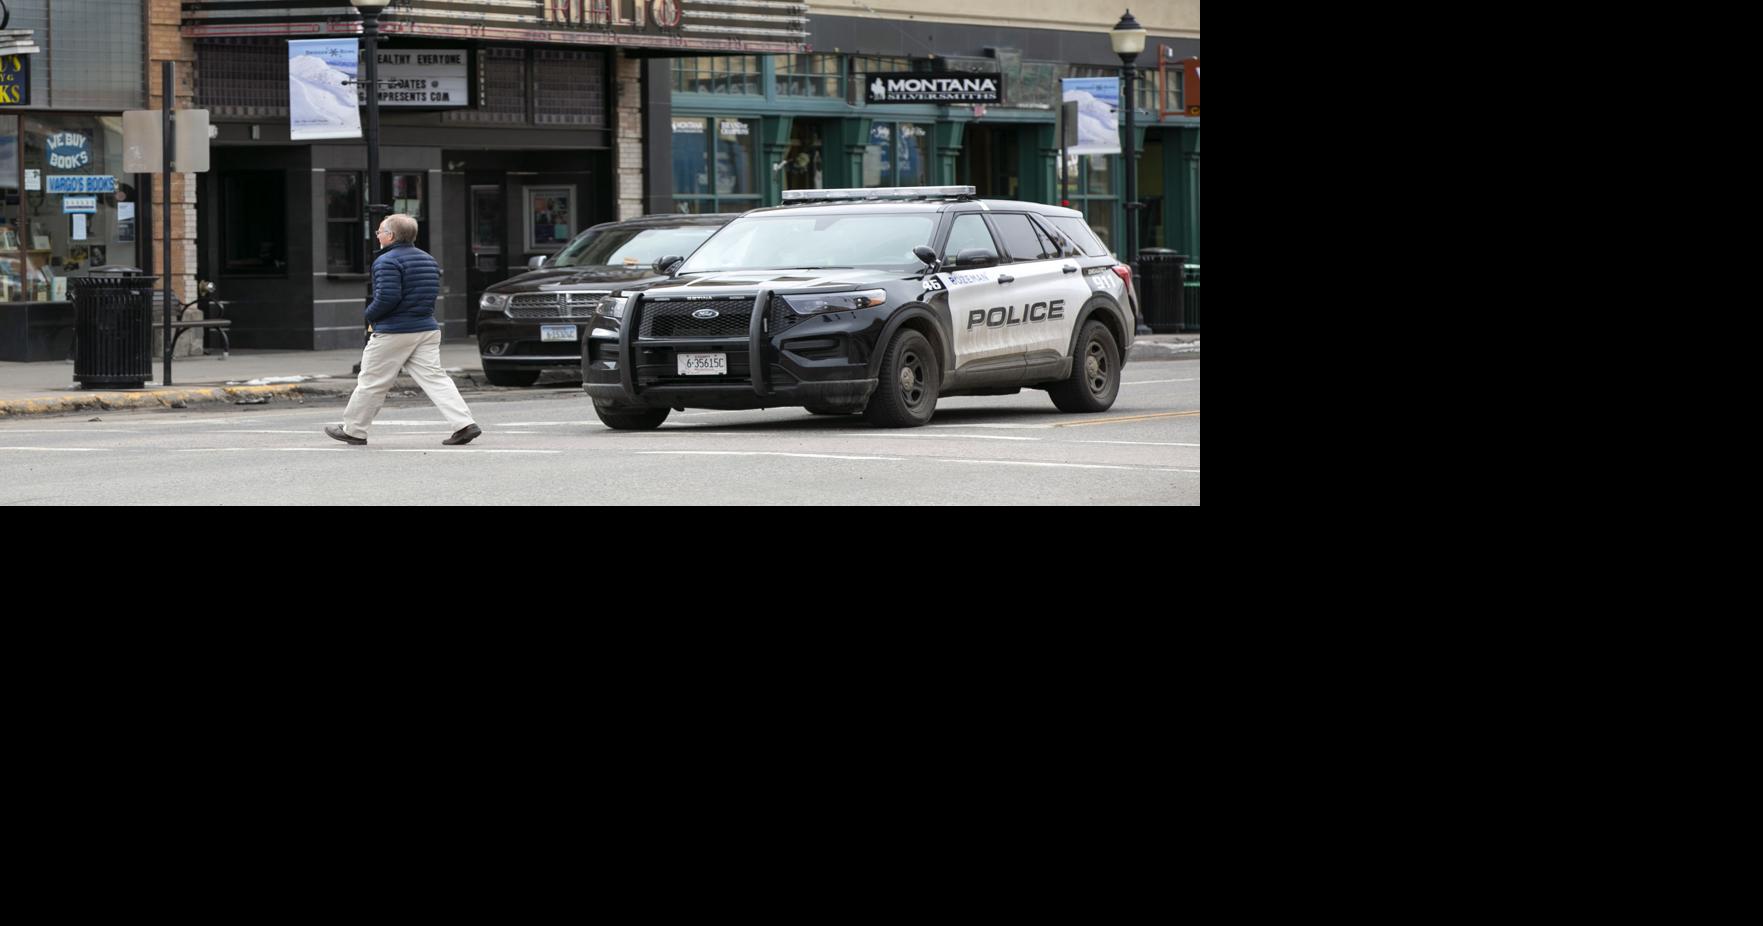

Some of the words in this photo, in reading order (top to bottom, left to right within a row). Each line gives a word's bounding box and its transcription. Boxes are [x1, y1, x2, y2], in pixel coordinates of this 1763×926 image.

[377, 54, 411, 64] EALTHY
[417, 54, 461, 64] EVERYONE
[887, 79, 997, 92] MONTANA
[47, 132, 64, 149] WE
[65, 132, 87, 148] BUY
[49, 151, 88, 169] BOOKS
[49, 177, 84, 191] VARGO'S
[86, 177, 114, 191] BOOKS
[923, 279, 942, 291] 46
[1092, 274, 1116, 289] 911
[967, 299, 1065, 331] POLICE
